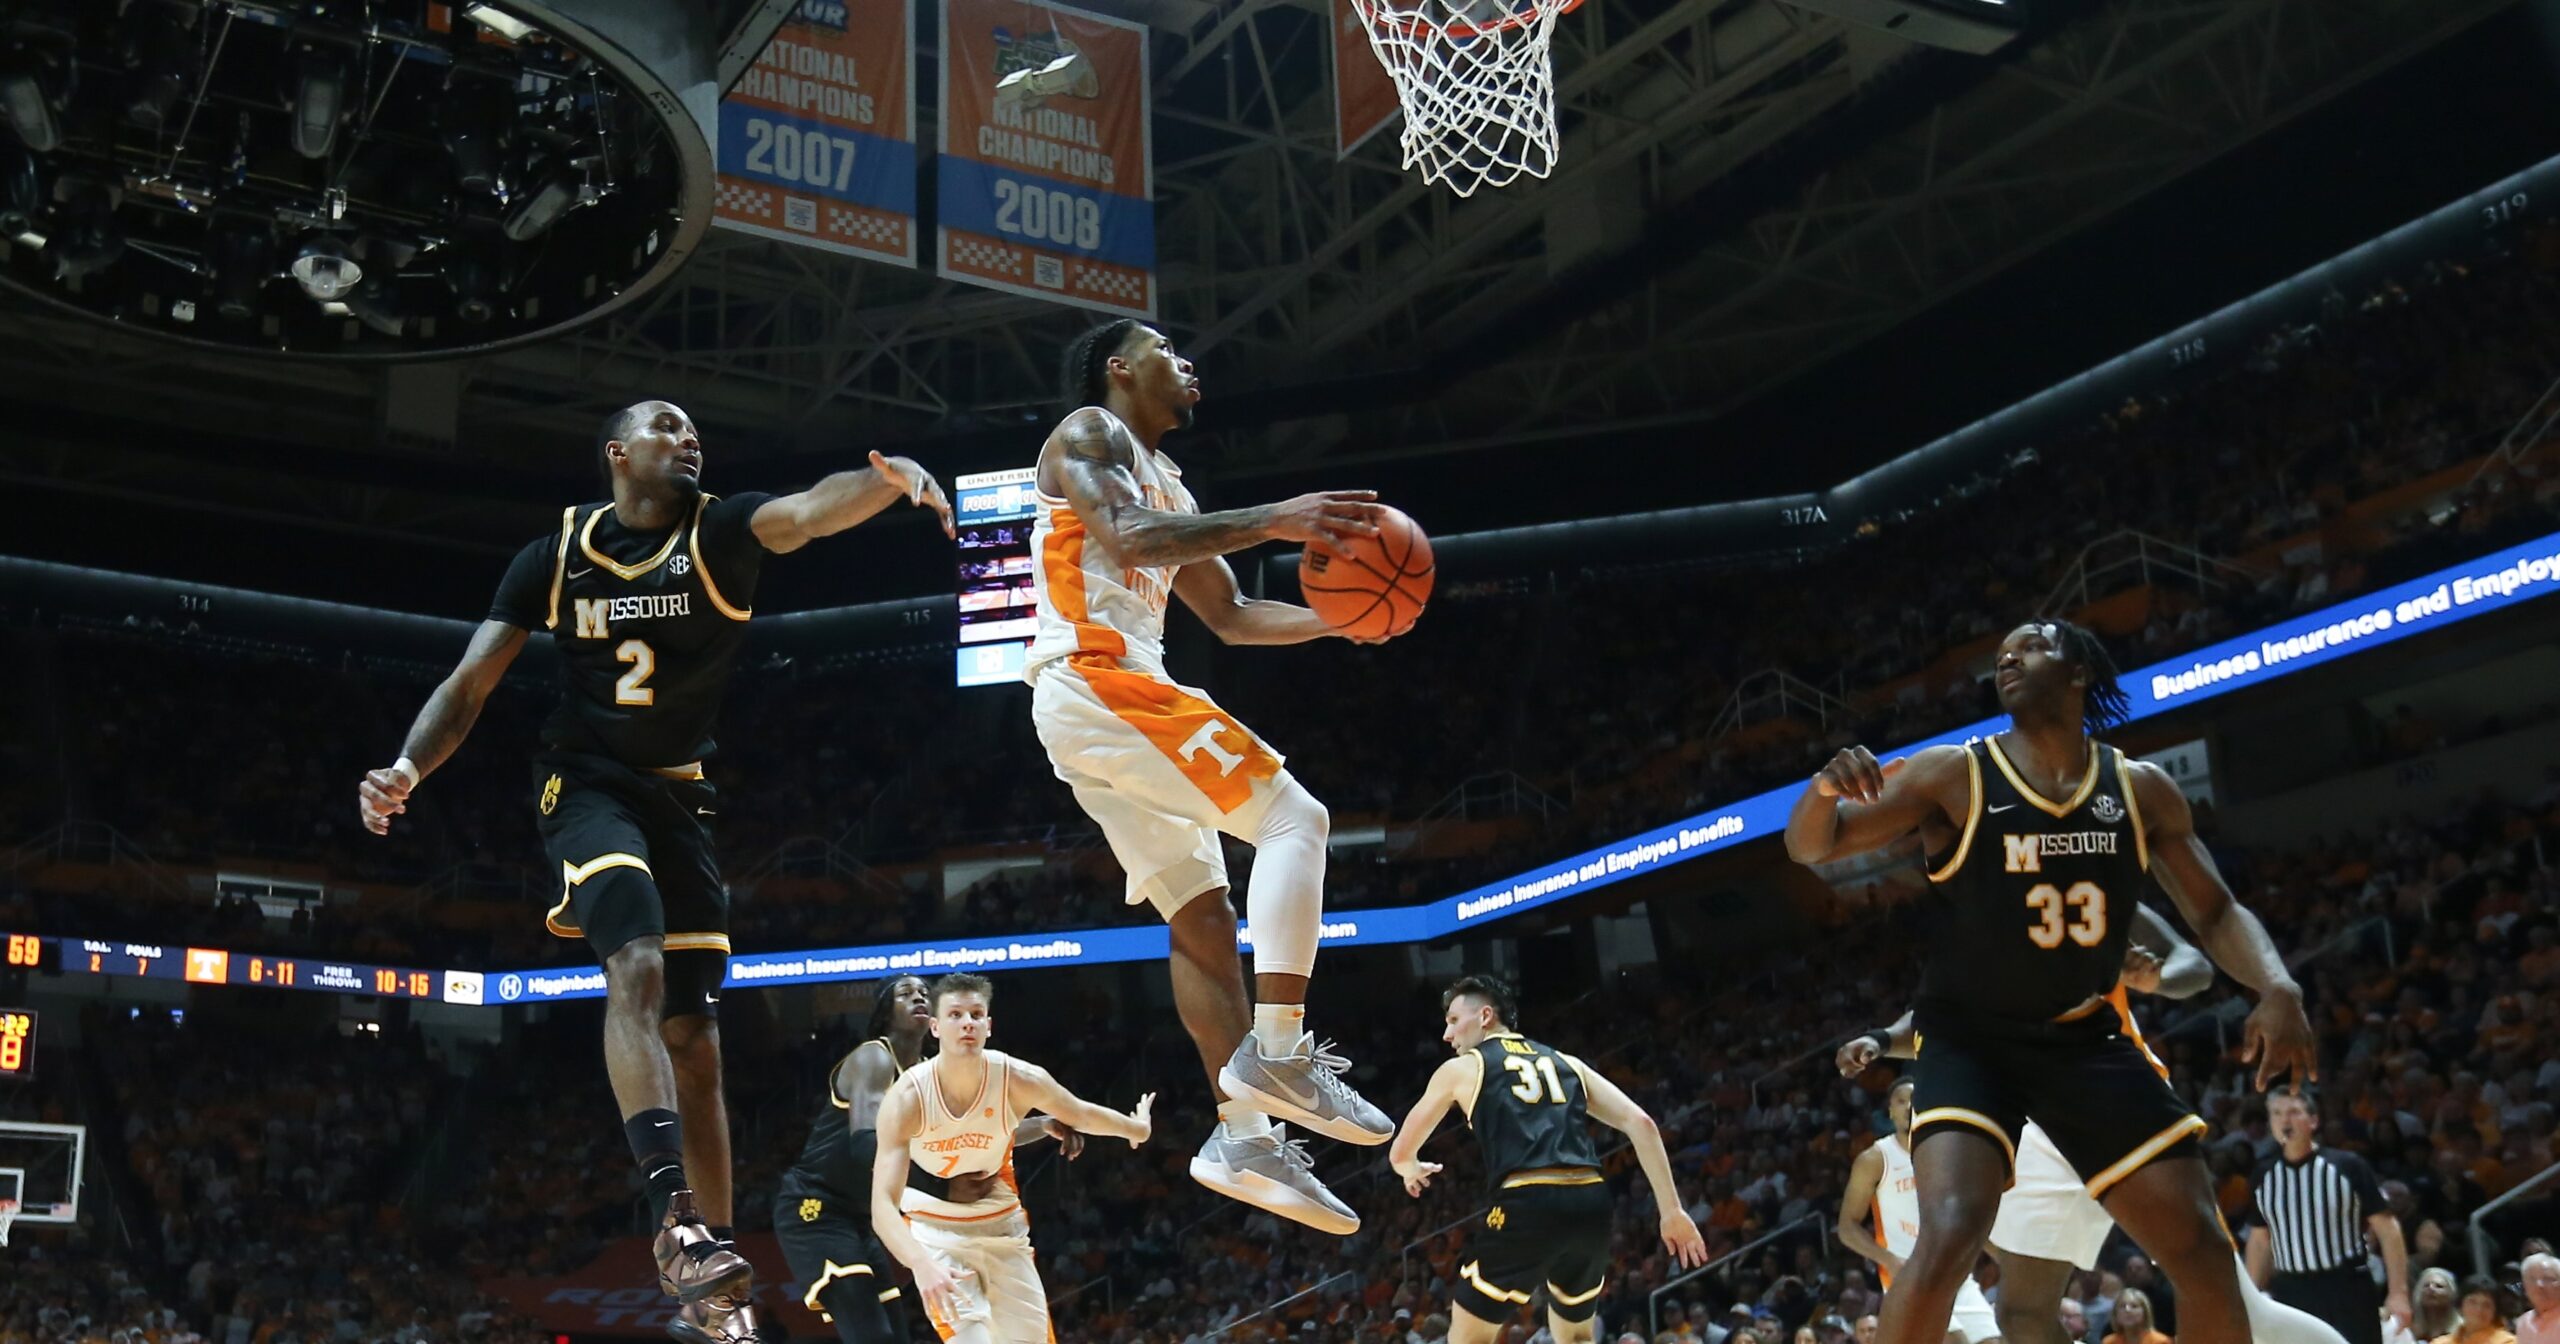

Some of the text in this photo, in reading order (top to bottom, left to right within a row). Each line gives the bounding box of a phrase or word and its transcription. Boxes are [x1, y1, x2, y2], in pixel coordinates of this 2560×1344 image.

[757, 40, 859, 88] ATIONAL
[732, 67, 875, 125] HAMPIONS
[745, 118, 856, 191] 2007
[978, 125, 1114, 184] CHAMPIONS
[994, 178, 1100, 250] 2008
[2482, 193, 2528, 230] 319
[2169, 338, 2206, 366] 318
[962, 494, 998, 511] FOOD
[1781, 506, 1828, 526] 317A
[669, 555, 691, 575] SEC
[178, 593, 211, 613] 314
[574, 593, 691, 639] MISSOURI
[902, 608, 931, 626] 315
[2151, 651, 2260, 700] Business
[2262, 609, 2393, 665] Insurance
[2395, 585, 2451, 624] and
[615, 640, 655, 706] 2
[1177, 718, 1246, 778] T
[1457, 816, 1744, 921] Business Insurance and Employee Benefits
[2003, 831, 2117, 873] MISSOURI
[2026, 881, 2107, 949] 33
[8, 934, 41, 966] 59
[90, 953, 101, 973] 2
[125, 943, 162, 958] FOULS
[138, 957, 148, 976] 7
[731, 940, 1082, 980] Business Insurance and Employee Benefits
[312, 974, 363, 989] THROWS
[323, 965, 353, 977] FREE
[1503, 1055, 1568, 1104] 31
[922, 1133, 995, 1153] TENNESSEE
[937, 1155, 961, 1177] 7
